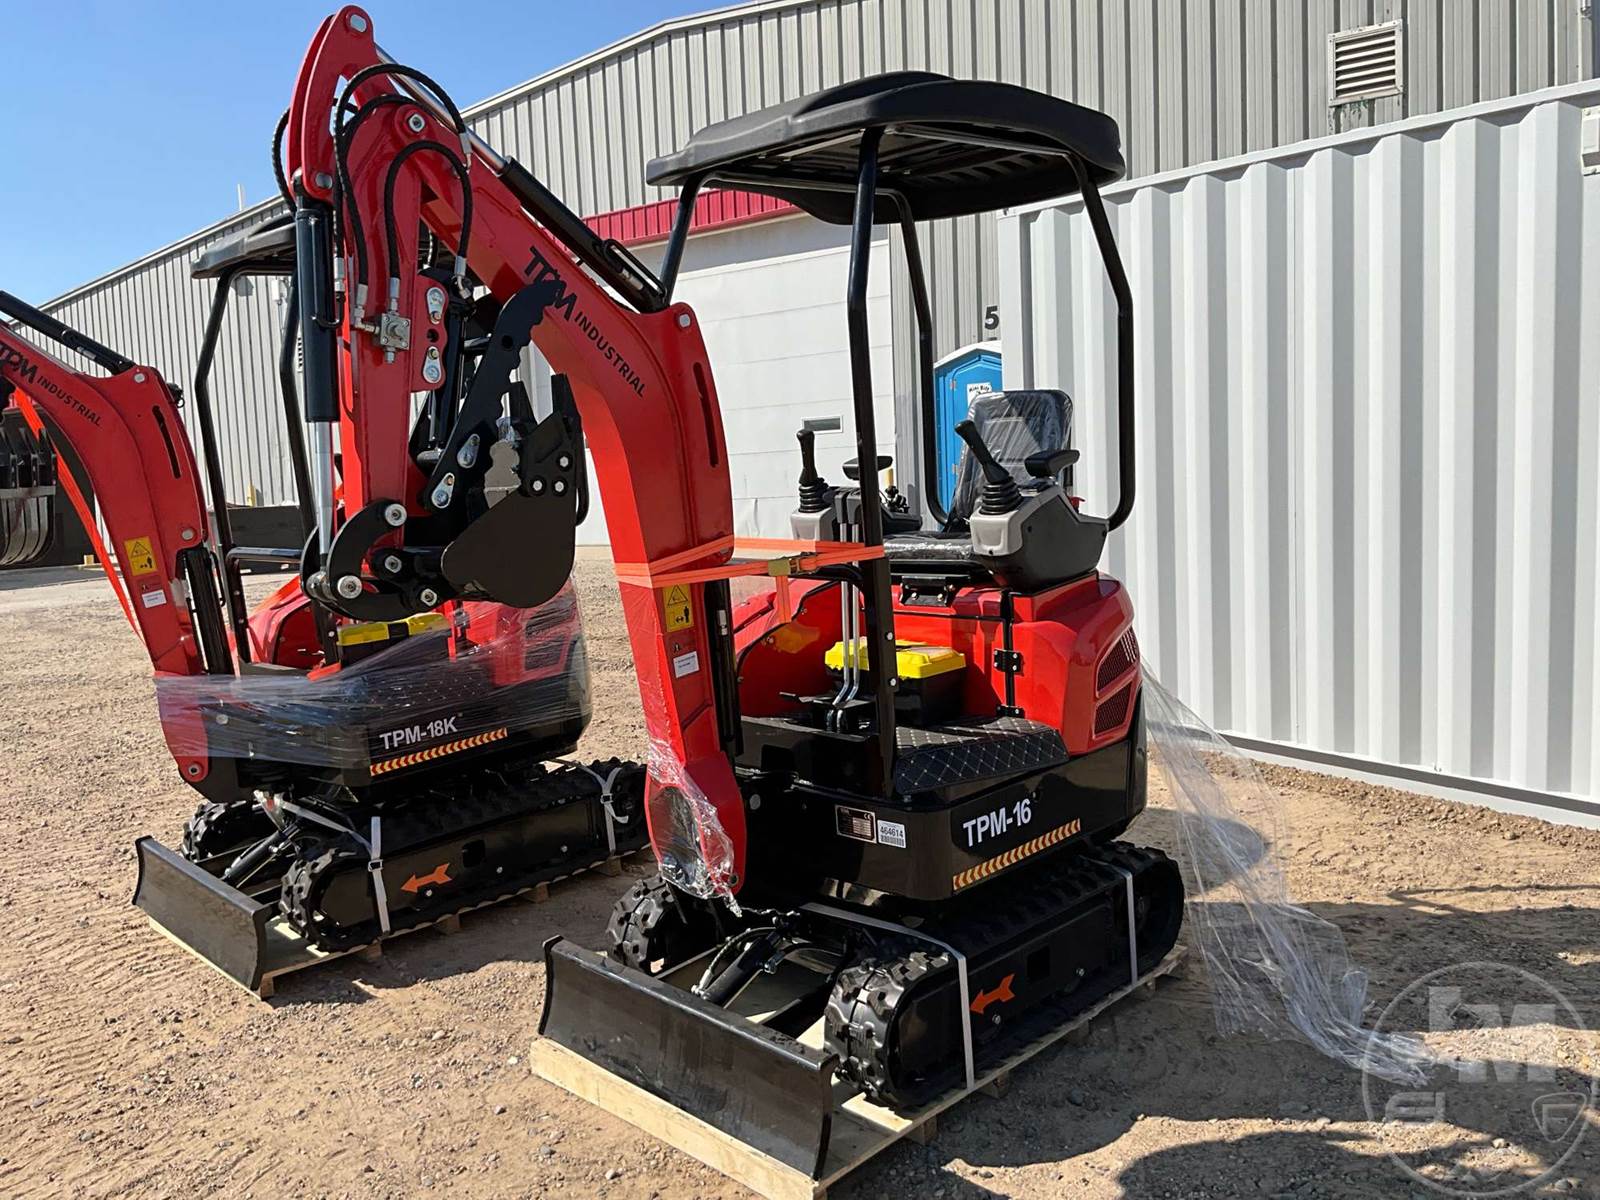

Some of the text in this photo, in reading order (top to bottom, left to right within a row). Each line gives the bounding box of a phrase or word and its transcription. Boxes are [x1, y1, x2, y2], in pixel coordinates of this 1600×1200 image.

[984, 305, 1000, 330] 5
[574, 311, 646, 397] INDUSTRIAL
[37, 376, 103, 427] INDUSTRIAL
[379, 716, 458, 750] TPM-18K
[963, 798, 1032, 847] TPM-16
